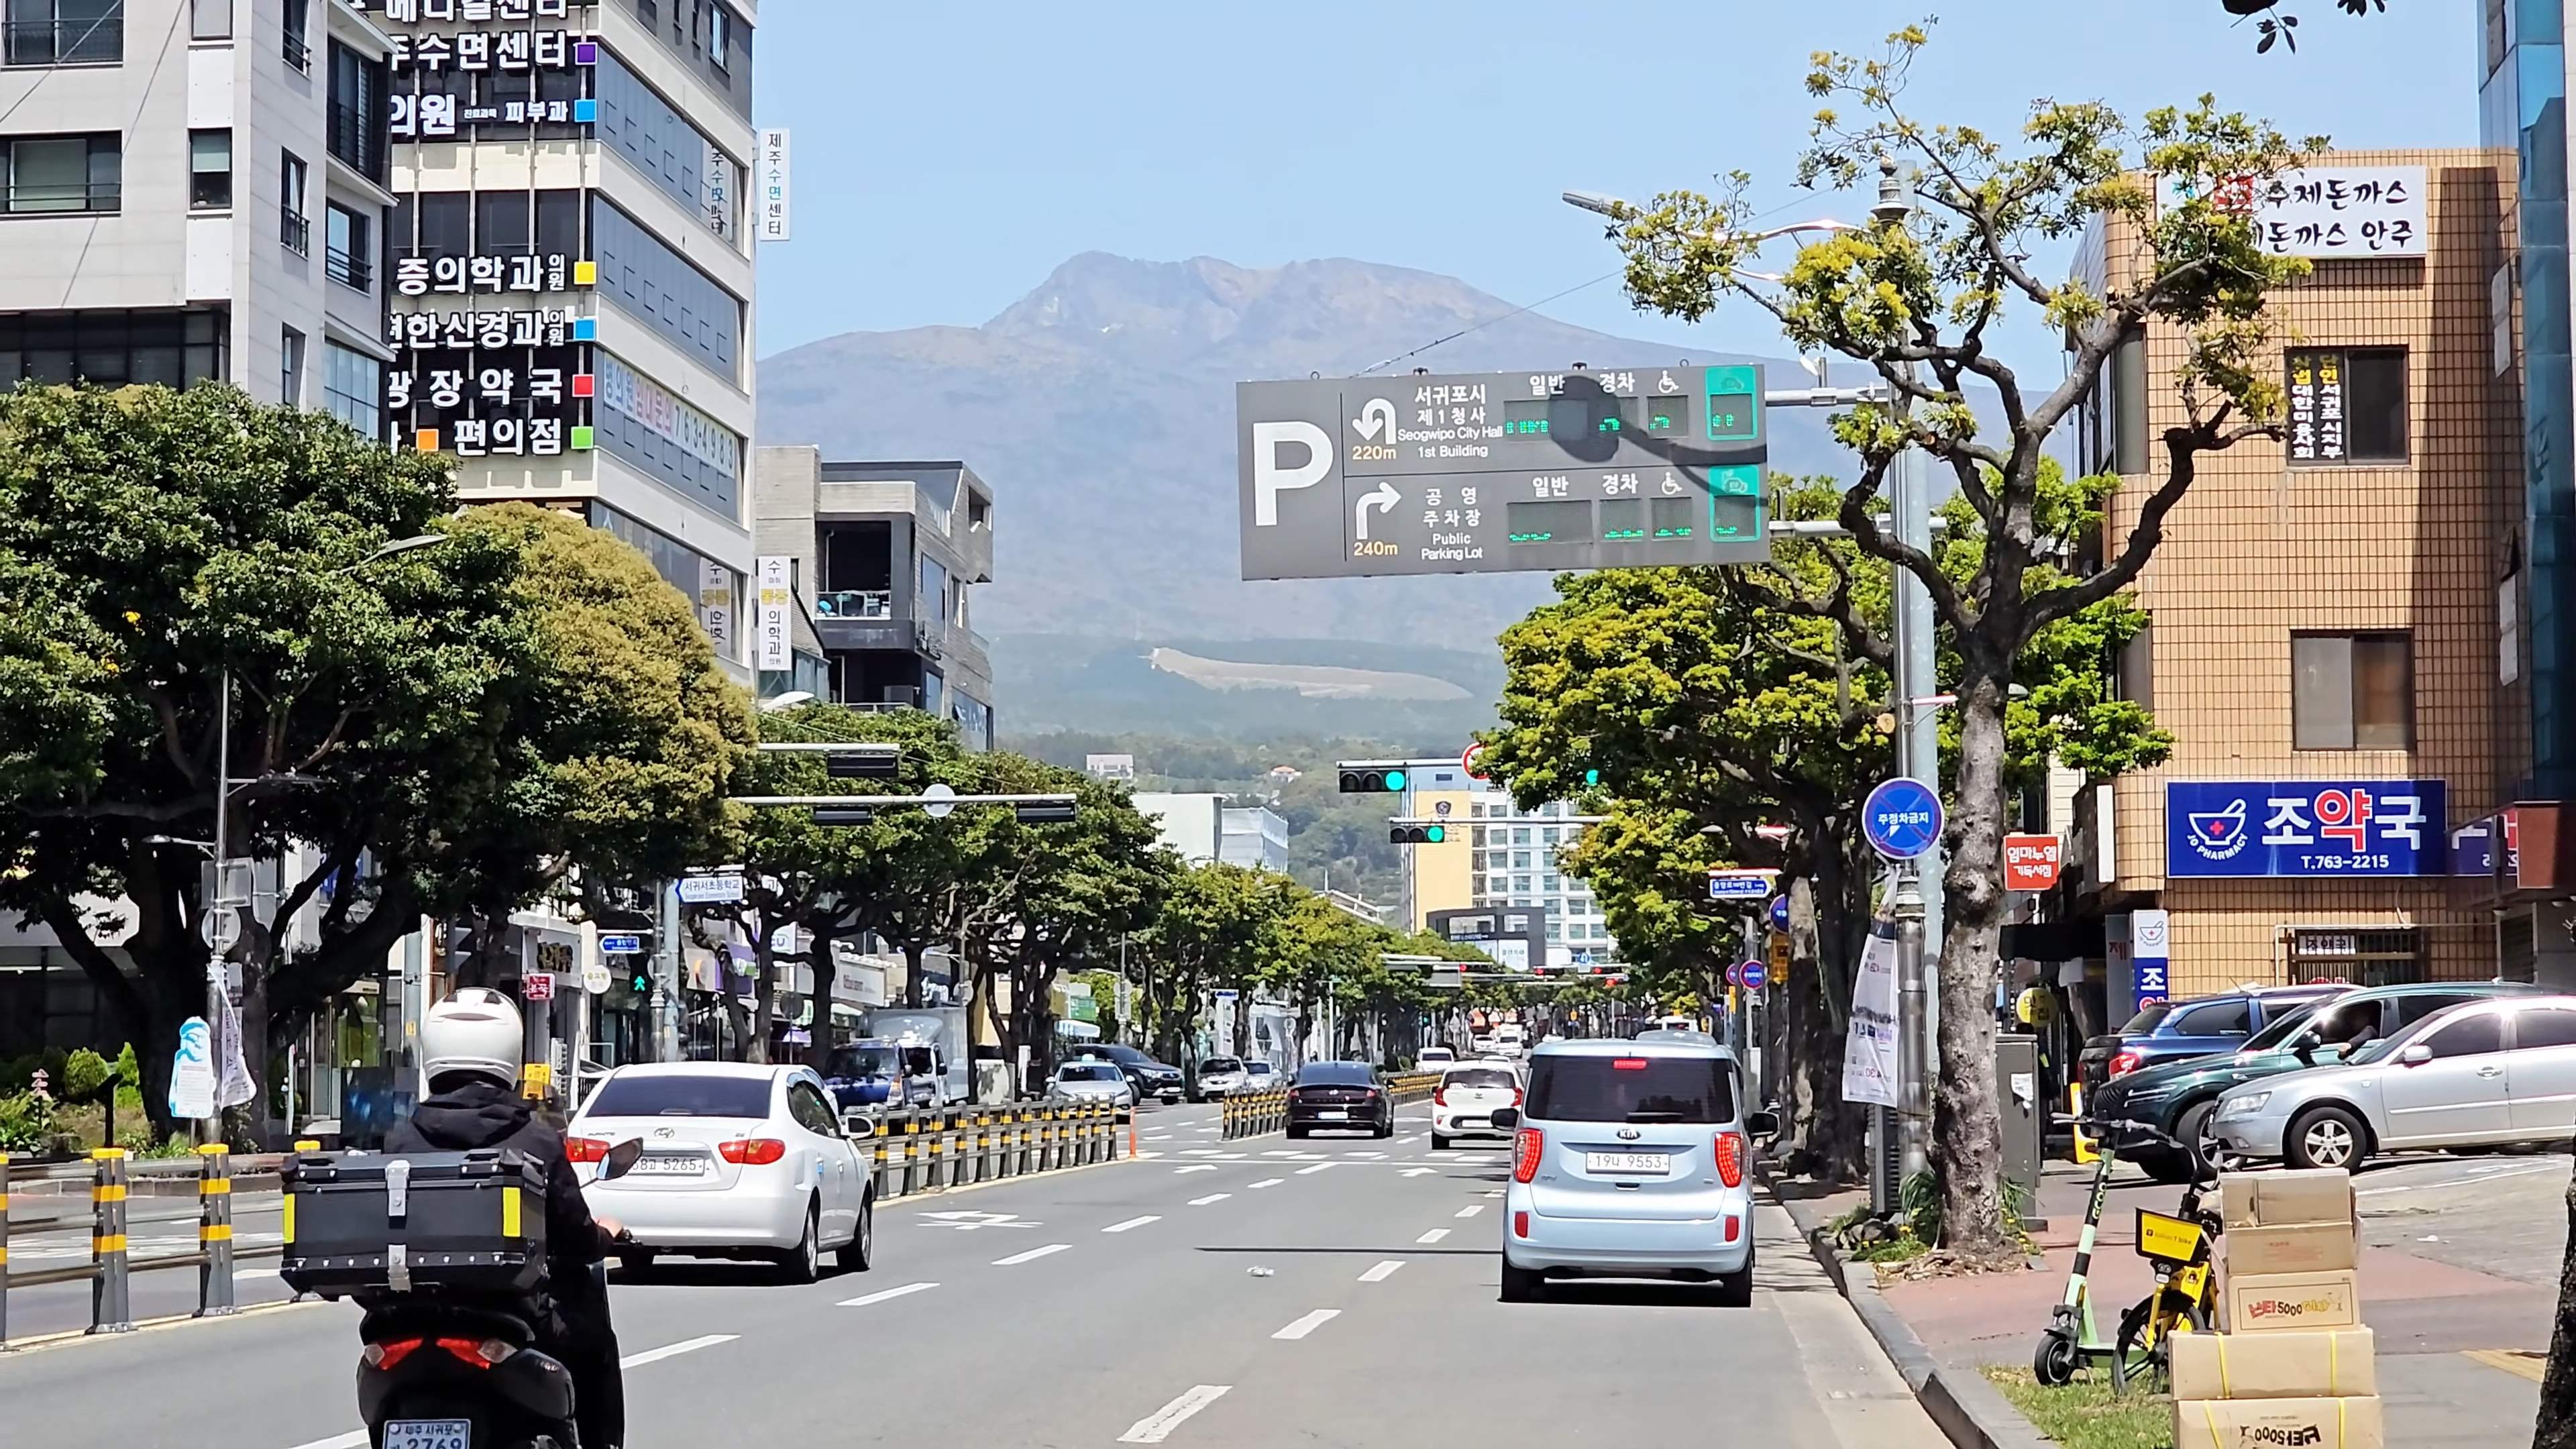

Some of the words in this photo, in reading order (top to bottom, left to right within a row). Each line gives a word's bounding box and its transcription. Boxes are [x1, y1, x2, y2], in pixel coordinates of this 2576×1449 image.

[390, 94, 455, 136] 의원
[505, 101, 569, 123] 피부과
[768, 133, 782, 235] 제주수면센터
[2255, 220, 2348, 253] 돈까스
[2361, 220, 2414, 251] 안주
[396, 256, 544, 296] 증의학과
[1529, 374, 1566, 396] 일반
[1599, 371, 1635, 394] 경차
[1414, 384, 1486, 406] 서귀포시
[2291, 384, 2316, 459] 대한미용사회
[2319, 384, 2344, 459] 서귀포시지부
[454, 418, 561, 455] 편의점
[675, 405, 734, 470] 763-4983
[1397, 429, 1455, 442] Seogwipo
[1456, 427, 1481, 441] City
[1482, 426, 1503, 438] Hall
[1352, 445, 1397, 460] 220m
[1417, 446, 1436, 458] 1st
[1439, 445, 1489, 459] Building
[1252, 421, 1334, 527] P
[1602, 472, 1638, 495] 경차
[1532, 475, 1569, 498] 일반
[1353, 541, 1399, 556] 240m
[1432, 532, 1471, 545] Public
[1421, 549, 1463, 561] Parking
[1464, 547, 1483, 559] Lot
[768, 560, 781, 574] 수
[768, 610, 782, 656] 의학과
[1877, 810, 1929, 826] 주정차금지
[2261, 788, 2427, 853] 조약국
[2006, 845, 2057, 863] 임마누엘
[2186, 833, 2200, 847] JO
[2197, 833, 2249, 861] PHARMACY
[2300, 855, 2390, 870] T.763-2215
[685, 879, 740, 892] 서귀서초등학교
[1619, 1130, 1639, 1138] KIA
[663, 1158, 696, 1171] 5265
[1627, 1155, 1662, 1168] 9553
